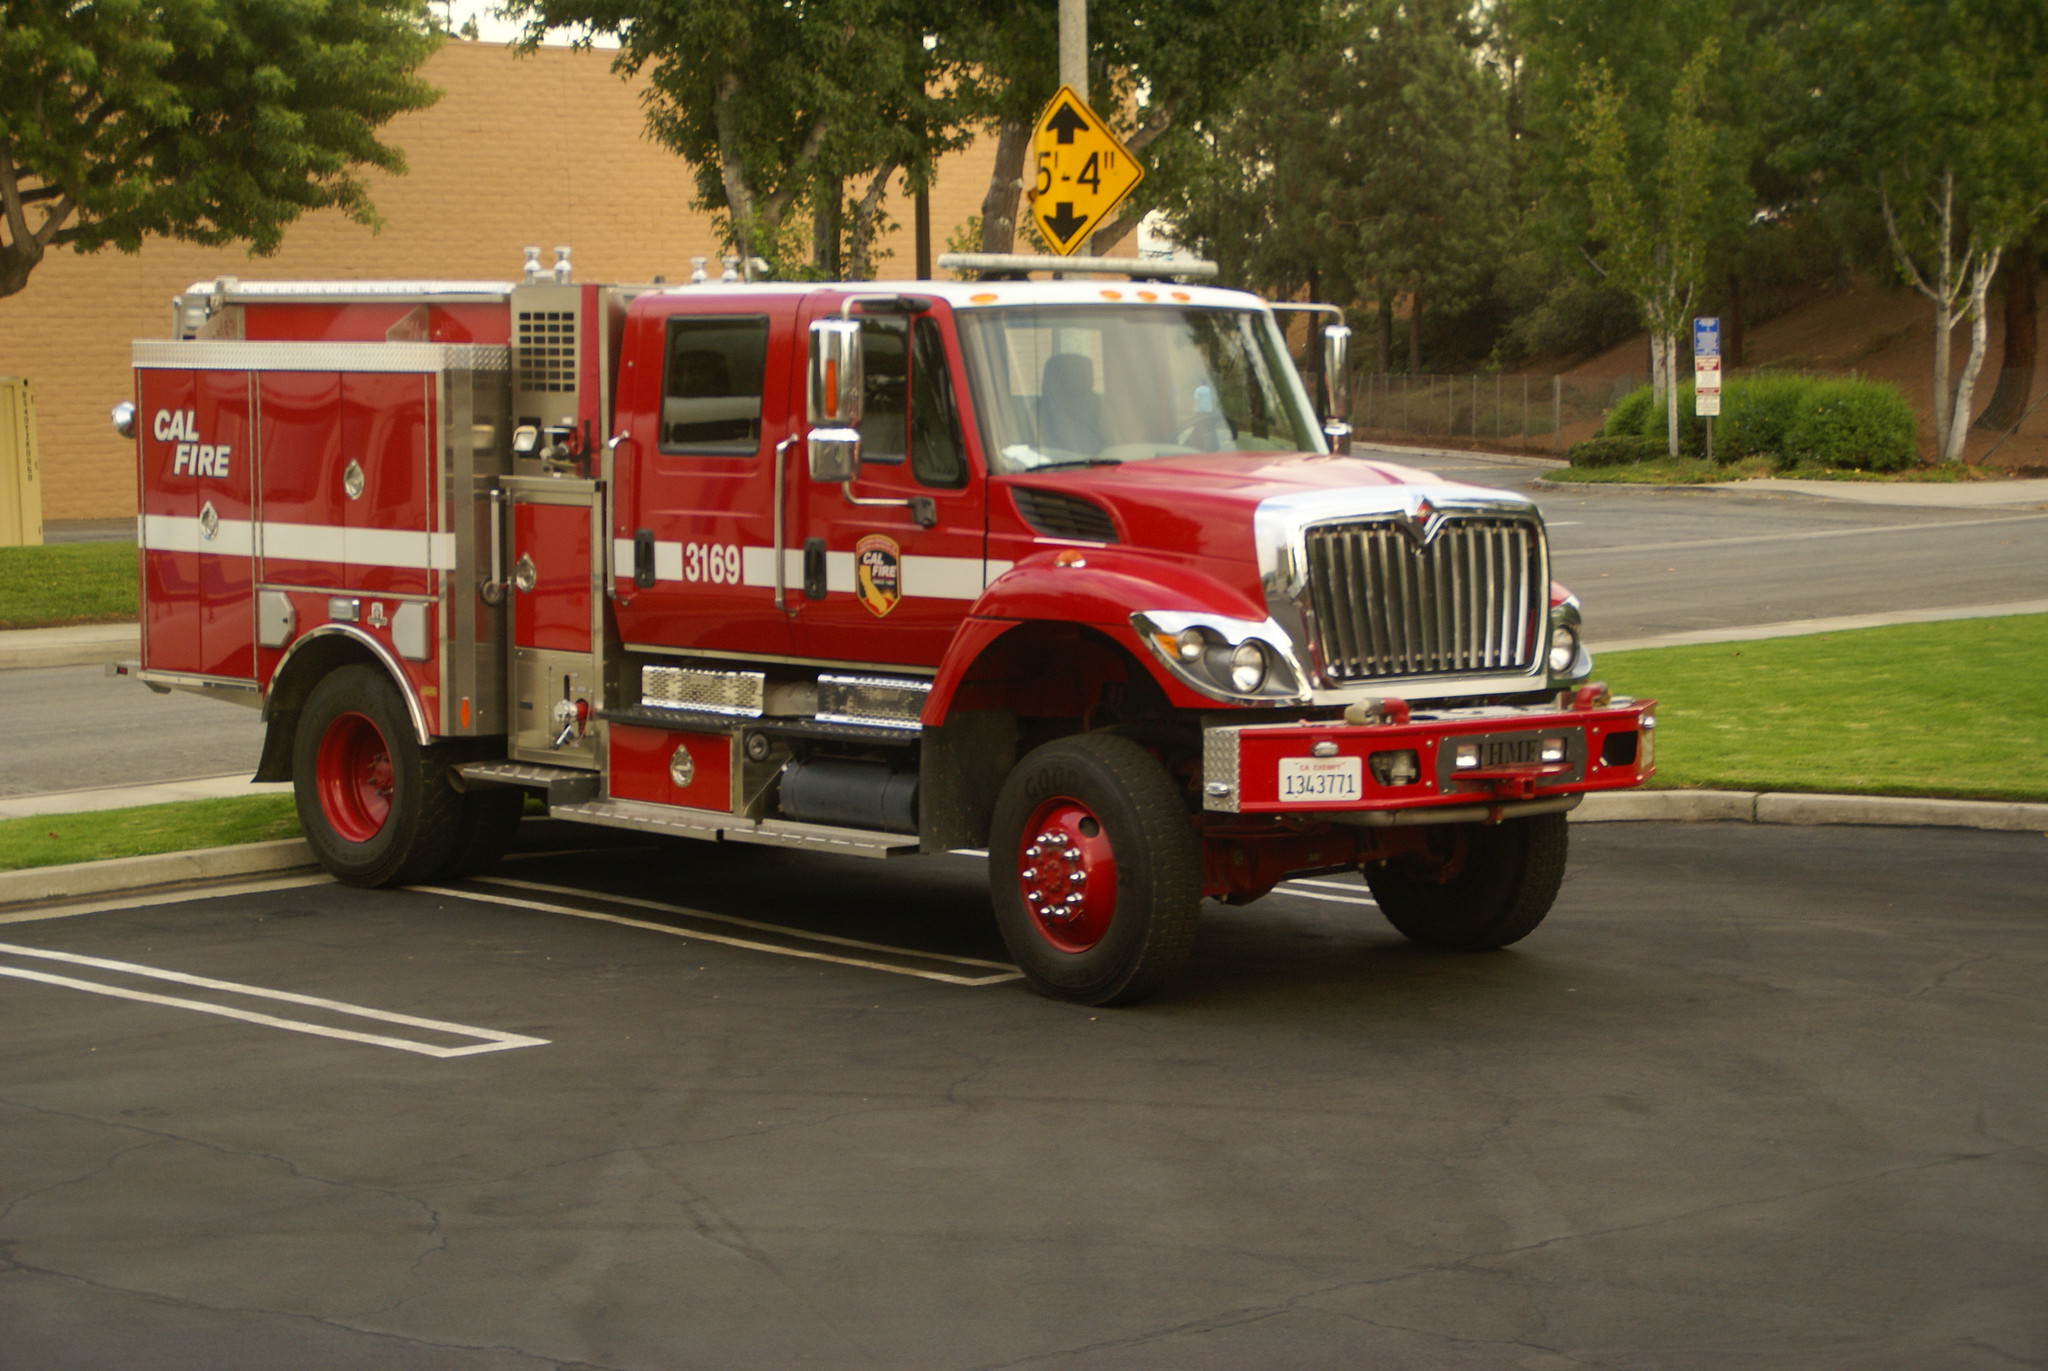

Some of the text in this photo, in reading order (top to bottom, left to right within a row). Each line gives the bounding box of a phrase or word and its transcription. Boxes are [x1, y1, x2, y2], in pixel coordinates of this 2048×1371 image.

[153, 408, 200, 442] CAL
[173, 443, 231, 478] FIRE
[685, 542, 740, 585] 3169
[862, 551, 884, 566] CAL
[872, 564, 897, 578] FIRE
[1485, 739, 1538, 766] HME
[1313, 763, 1342, 772] EXEMPT
[1285, 773, 1356, 795] 1343771
